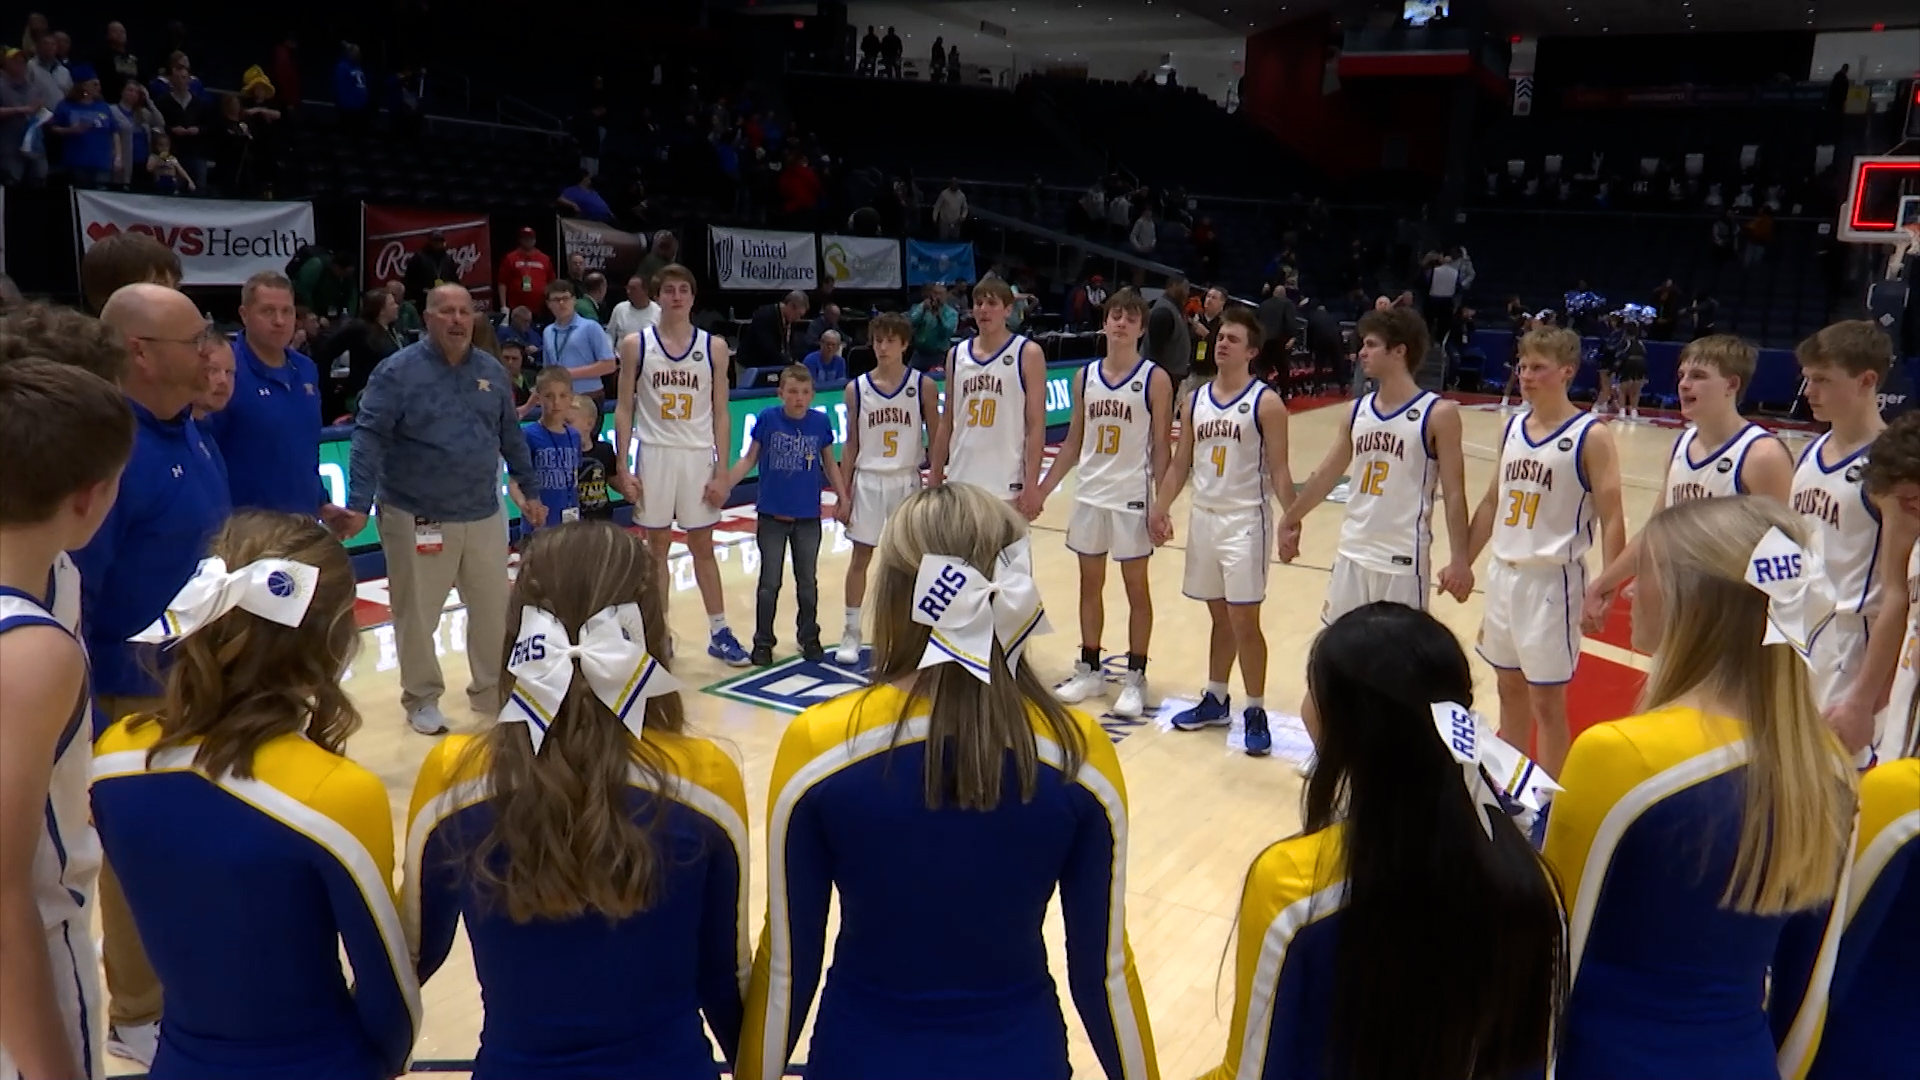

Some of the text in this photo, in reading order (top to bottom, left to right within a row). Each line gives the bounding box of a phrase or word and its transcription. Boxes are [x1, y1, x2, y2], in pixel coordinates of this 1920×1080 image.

[742, 239, 787, 258] United
[741, 261, 814, 280] Healthcare
[652, 369, 699, 391] RUSSIA
[963, 374, 1003, 397] RUSSIA
[661, 393, 693, 420] 23
[868, 407, 912, 429] RUSSIA
[967, 399, 996, 427] 50
[1088, 399, 1132, 423] RUSSIA
[882, 430, 899, 458] 5
[1096, 424, 1121, 454] 13
[1197, 419, 1241, 443] RUSSIA
[1356, 431, 1404, 461] RUSSIA
[1211, 445, 1227, 477] 4
[1505, 458, 1552, 491] RUSSIA
[1360, 461, 1389, 496] 12
[1504, 489, 1541, 529] 34
[1794, 487, 1840, 530] RUSSIA
[1753, 553, 1802, 583] RHS
[918, 563, 967, 622] RHS
[1451, 709, 1475, 760] RHS
